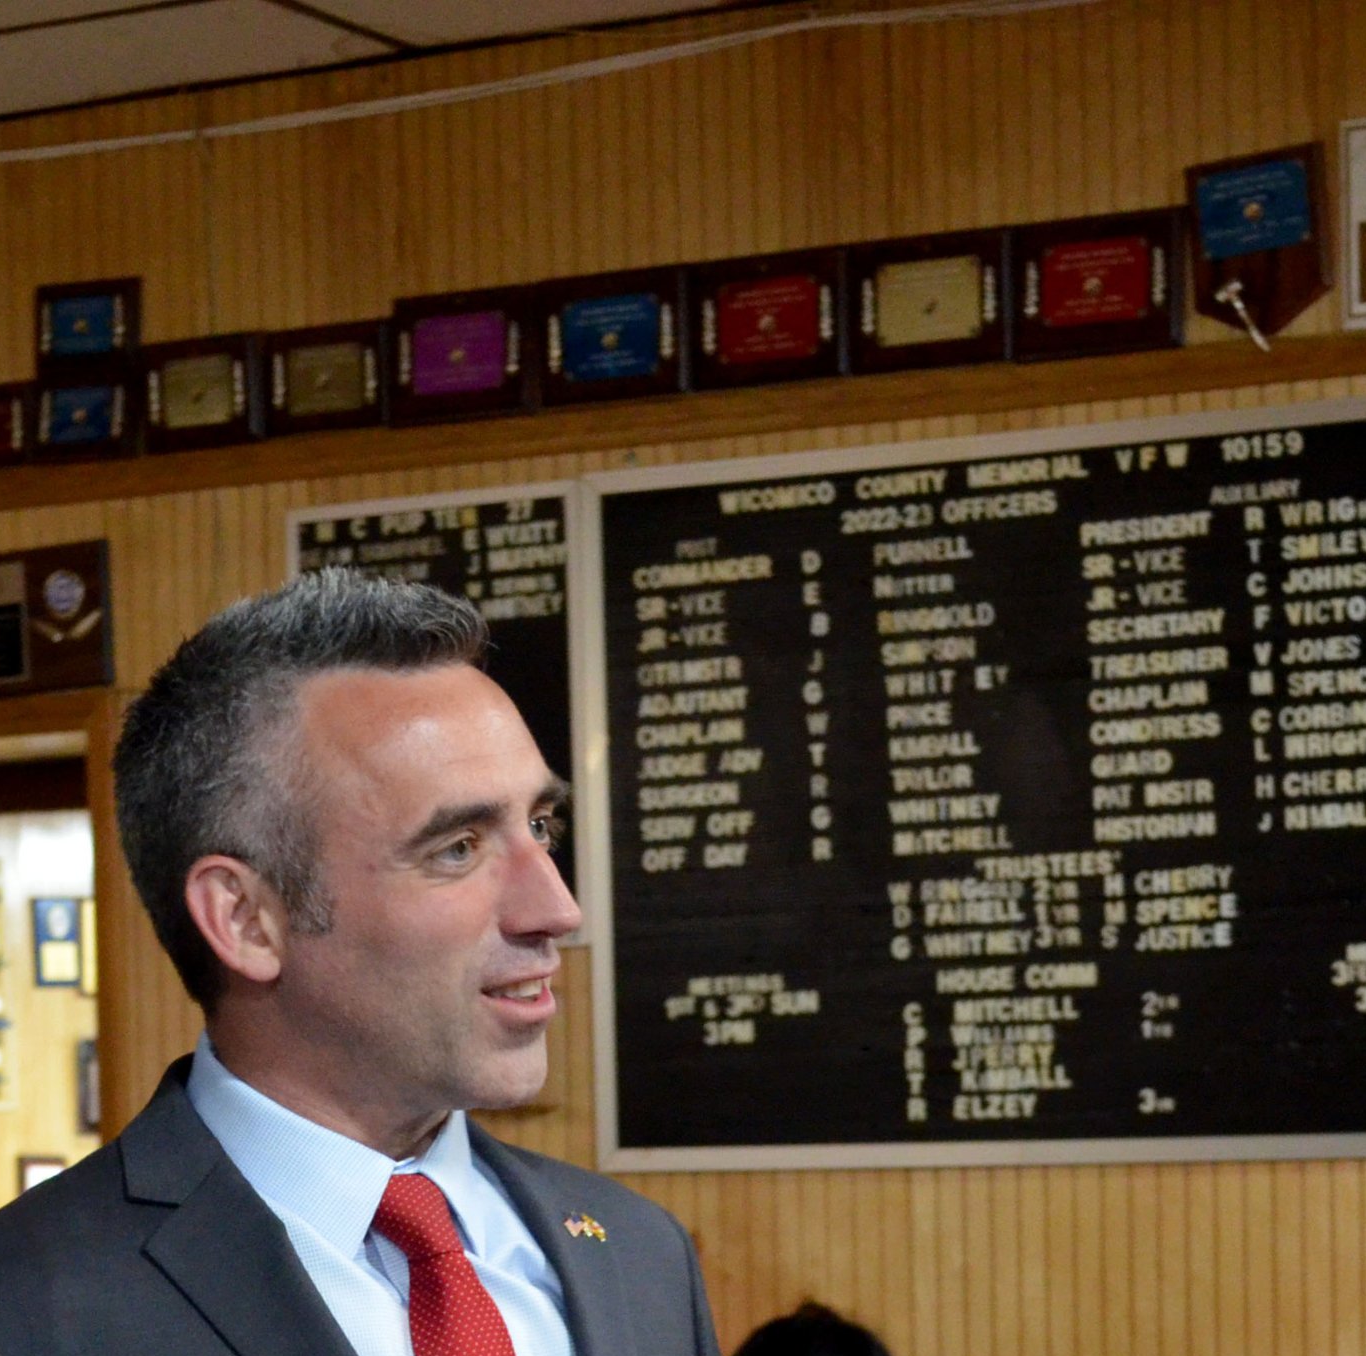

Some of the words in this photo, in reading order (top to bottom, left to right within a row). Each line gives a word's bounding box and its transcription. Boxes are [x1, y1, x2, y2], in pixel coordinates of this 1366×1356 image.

[857, 471, 947, 499] COUNTY
[968, 456, 1088, 487] MEMORIAL
[1221, 431, 1304, 462] 10159
[942, 491, 1056, 522] OFFICERS
[1081, 511, 1212, 546] PRESIDENT
[1245, 507, 1265, 530] R
[1248, 540, 1262, 563] T
[1248, 573, 1266, 596] C
[1088, 609, 1225, 643] SECRETARY
[1254, 606, 1269, 629] F
[1091, 647, 1228, 679] TREASURER
[1255, 643, 1271, 665] V
[1089, 682, 1208, 713] CHAPLAIN
[1252, 709, 1270, 732] C
[809, 743, 825, 766] T
[1255, 739, 1270, 761] L
[1257, 775, 1273, 798] H
[889, 795, 1000, 823] WHITNEY
[1095, 813, 1215, 842] HISTORIAN
[1258, 813, 1270, 832] J
[1105, 875, 1123, 896] H
[1136, 865, 1232, 895] CHERRY
[1137, 894, 1236, 924] SPENCE
[1102, 927, 1118, 948] S
[1136, 923, 1231, 950] JUSTICE
[938, 967, 1014, 993] HOUSE
[904, 1003, 922, 1025] C
[954, 997, 1078, 1023] MITCHELL
[907, 1026, 926, 1046] P
[908, 1073, 924, 1094] T
[954, 1094, 1036, 1119] ELZEY
